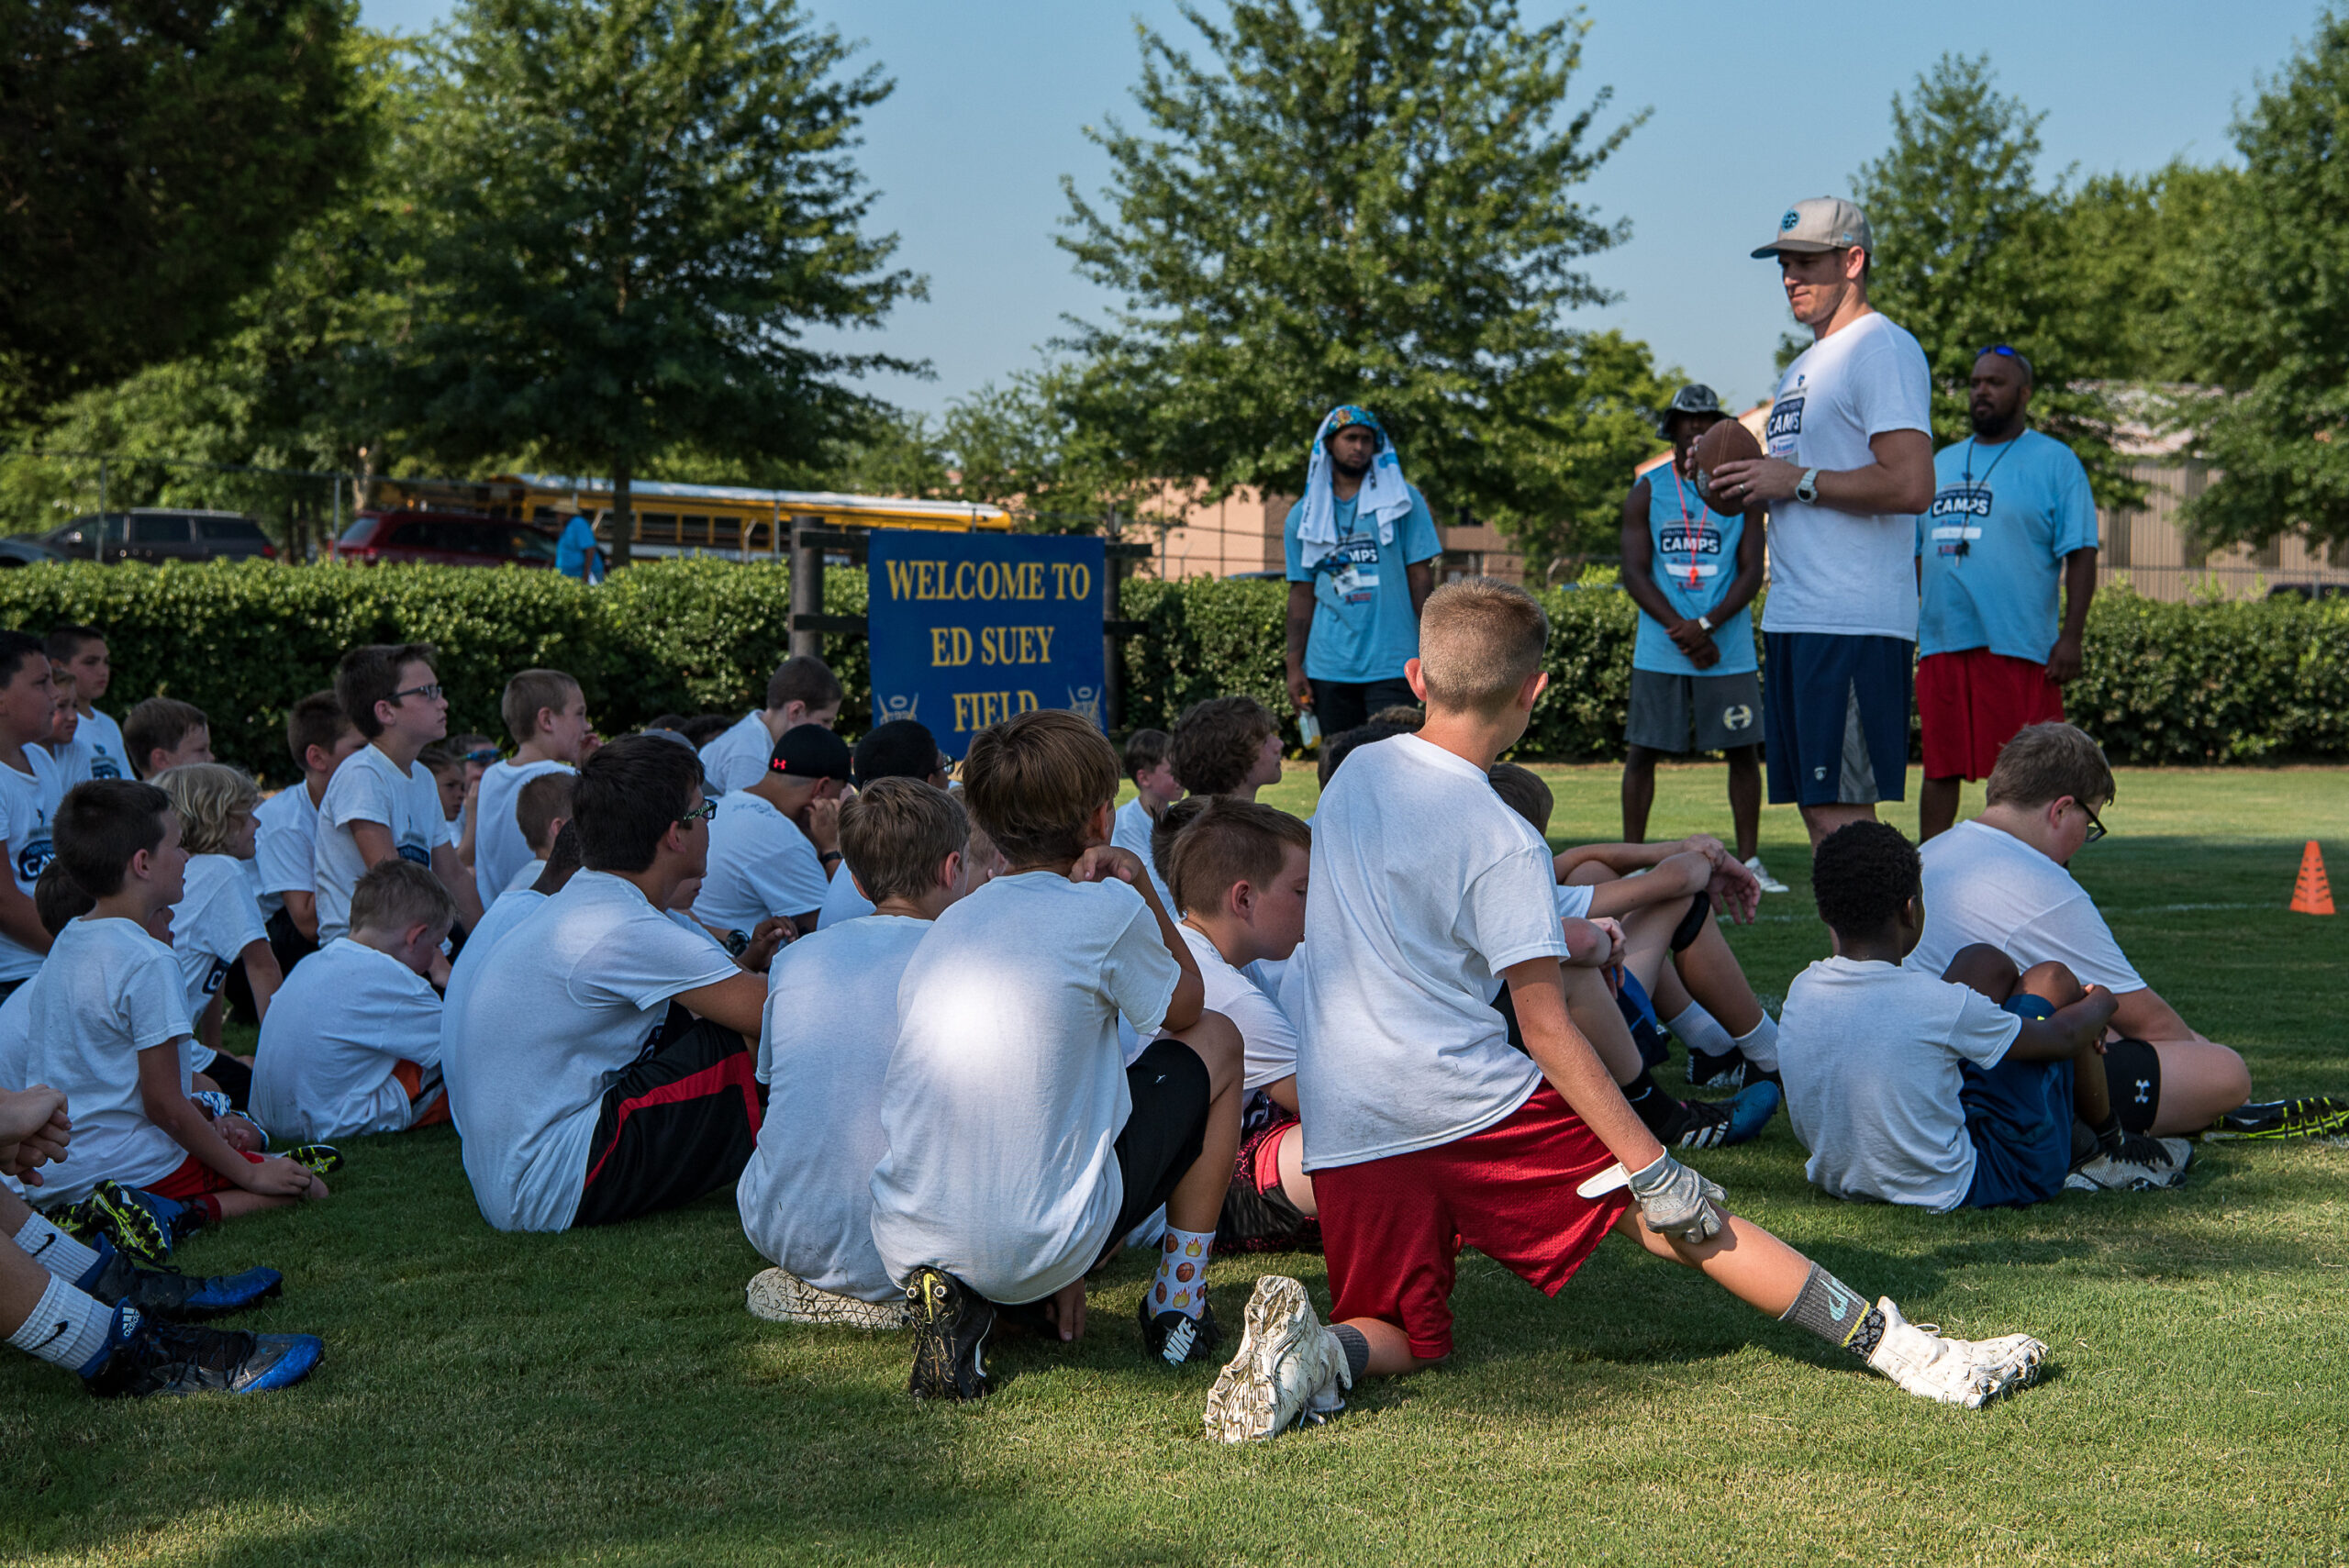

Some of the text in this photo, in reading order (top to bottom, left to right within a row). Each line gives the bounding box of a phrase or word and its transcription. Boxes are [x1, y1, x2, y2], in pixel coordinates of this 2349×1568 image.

[1767, 411, 1800, 437] CAMS
[1932, 497, 1988, 516] CAMPS
[1662, 537, 1719, 553] CAMPS
[885, 560, 1090, 601] WELCOME TO
[930, 626, 1054, 667] ED SUEY
[1163, 1316, 1197, 1363] NIKE
